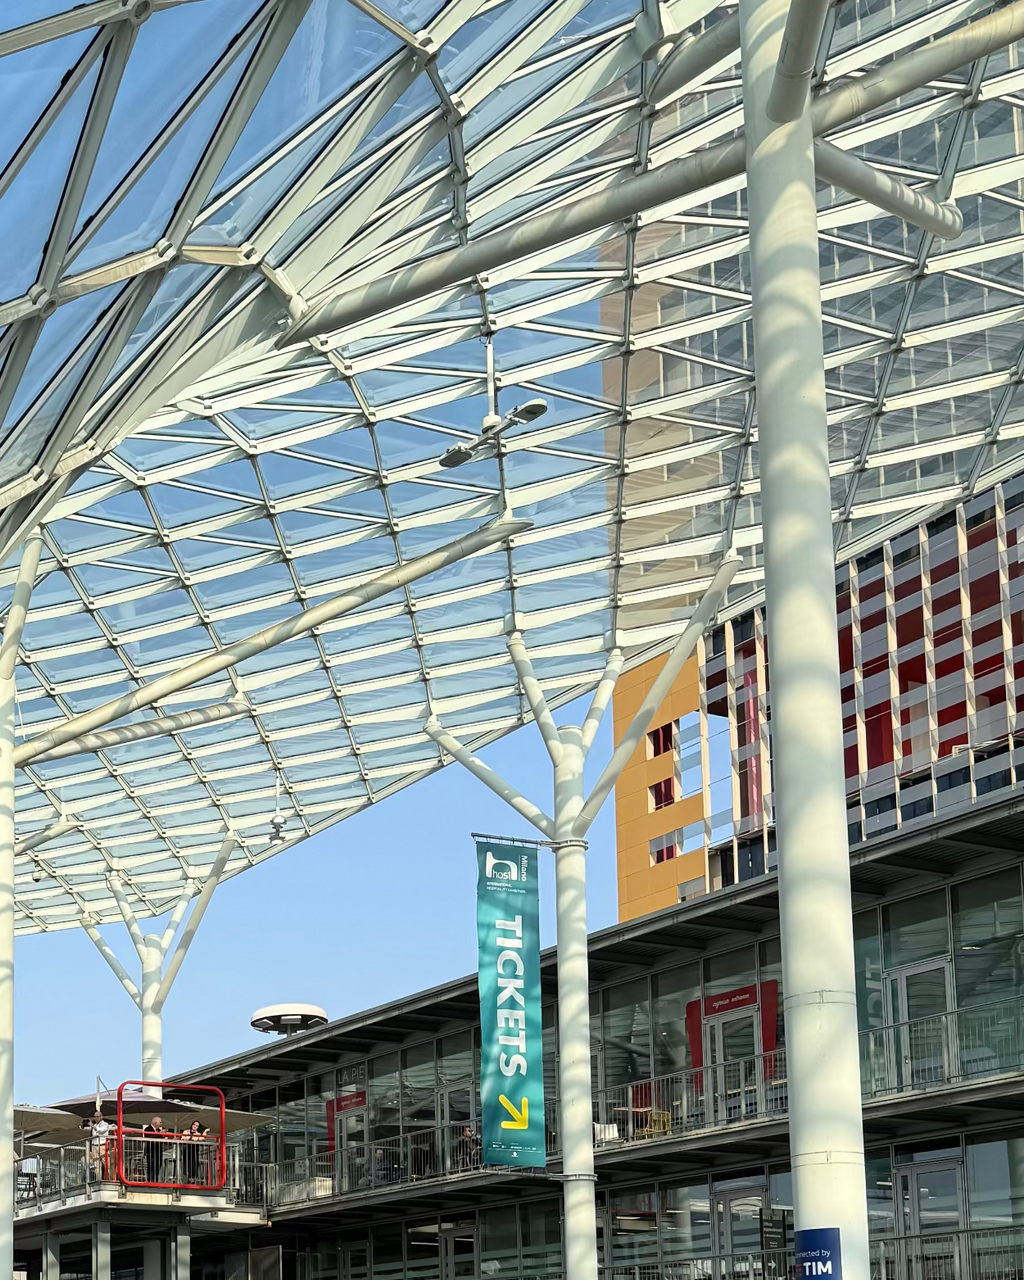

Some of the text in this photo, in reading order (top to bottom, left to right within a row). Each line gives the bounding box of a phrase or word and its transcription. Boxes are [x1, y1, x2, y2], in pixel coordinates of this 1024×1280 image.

[493, 869, 511, 880] host
[495, 915, 527, 1077] TICKETS
[338, 1065, 364, 1084] LA PIE
[821, 1249, 831, 1258] by
[803, 1260, 833, 1276] TIM
